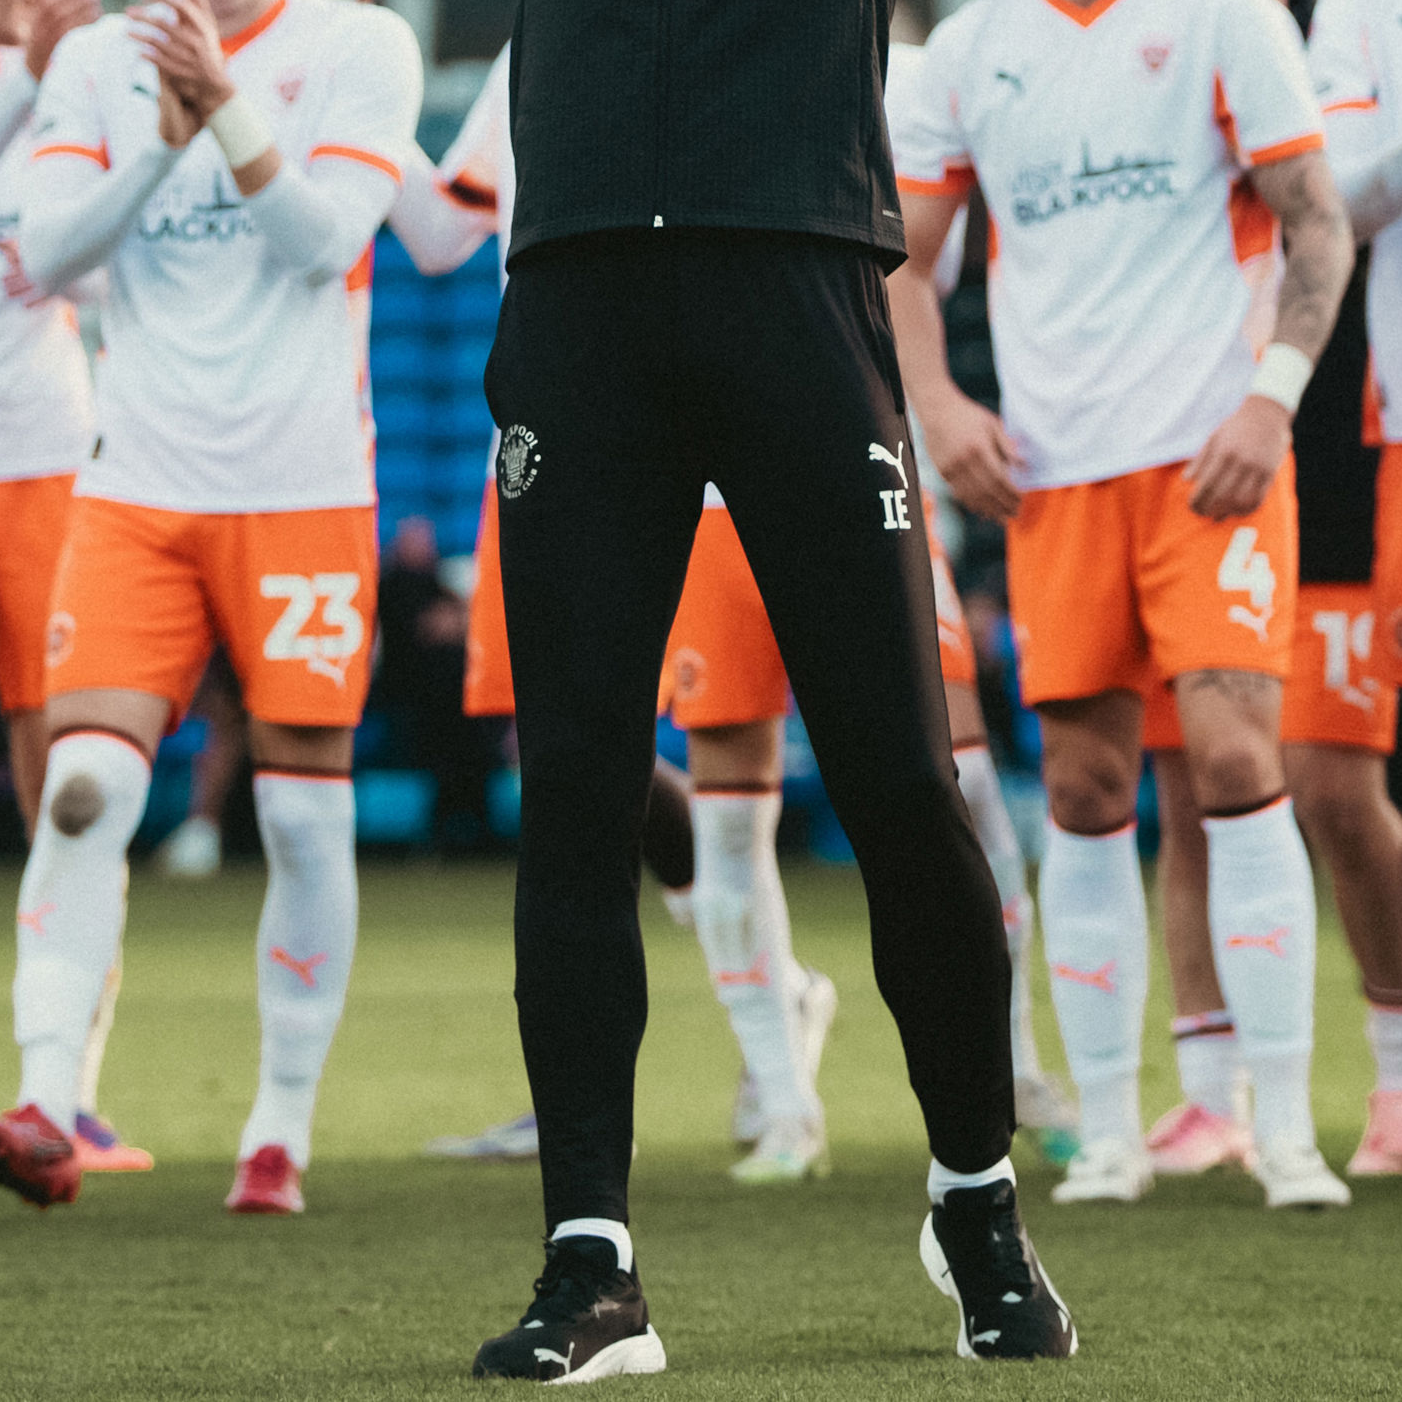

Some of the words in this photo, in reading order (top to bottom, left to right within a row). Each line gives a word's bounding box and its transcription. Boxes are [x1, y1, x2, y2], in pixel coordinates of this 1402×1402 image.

[879, 490, 911, 530] IE
[1218, 526, 1276, 610] 4
[260, 572, 363, 660] 23
